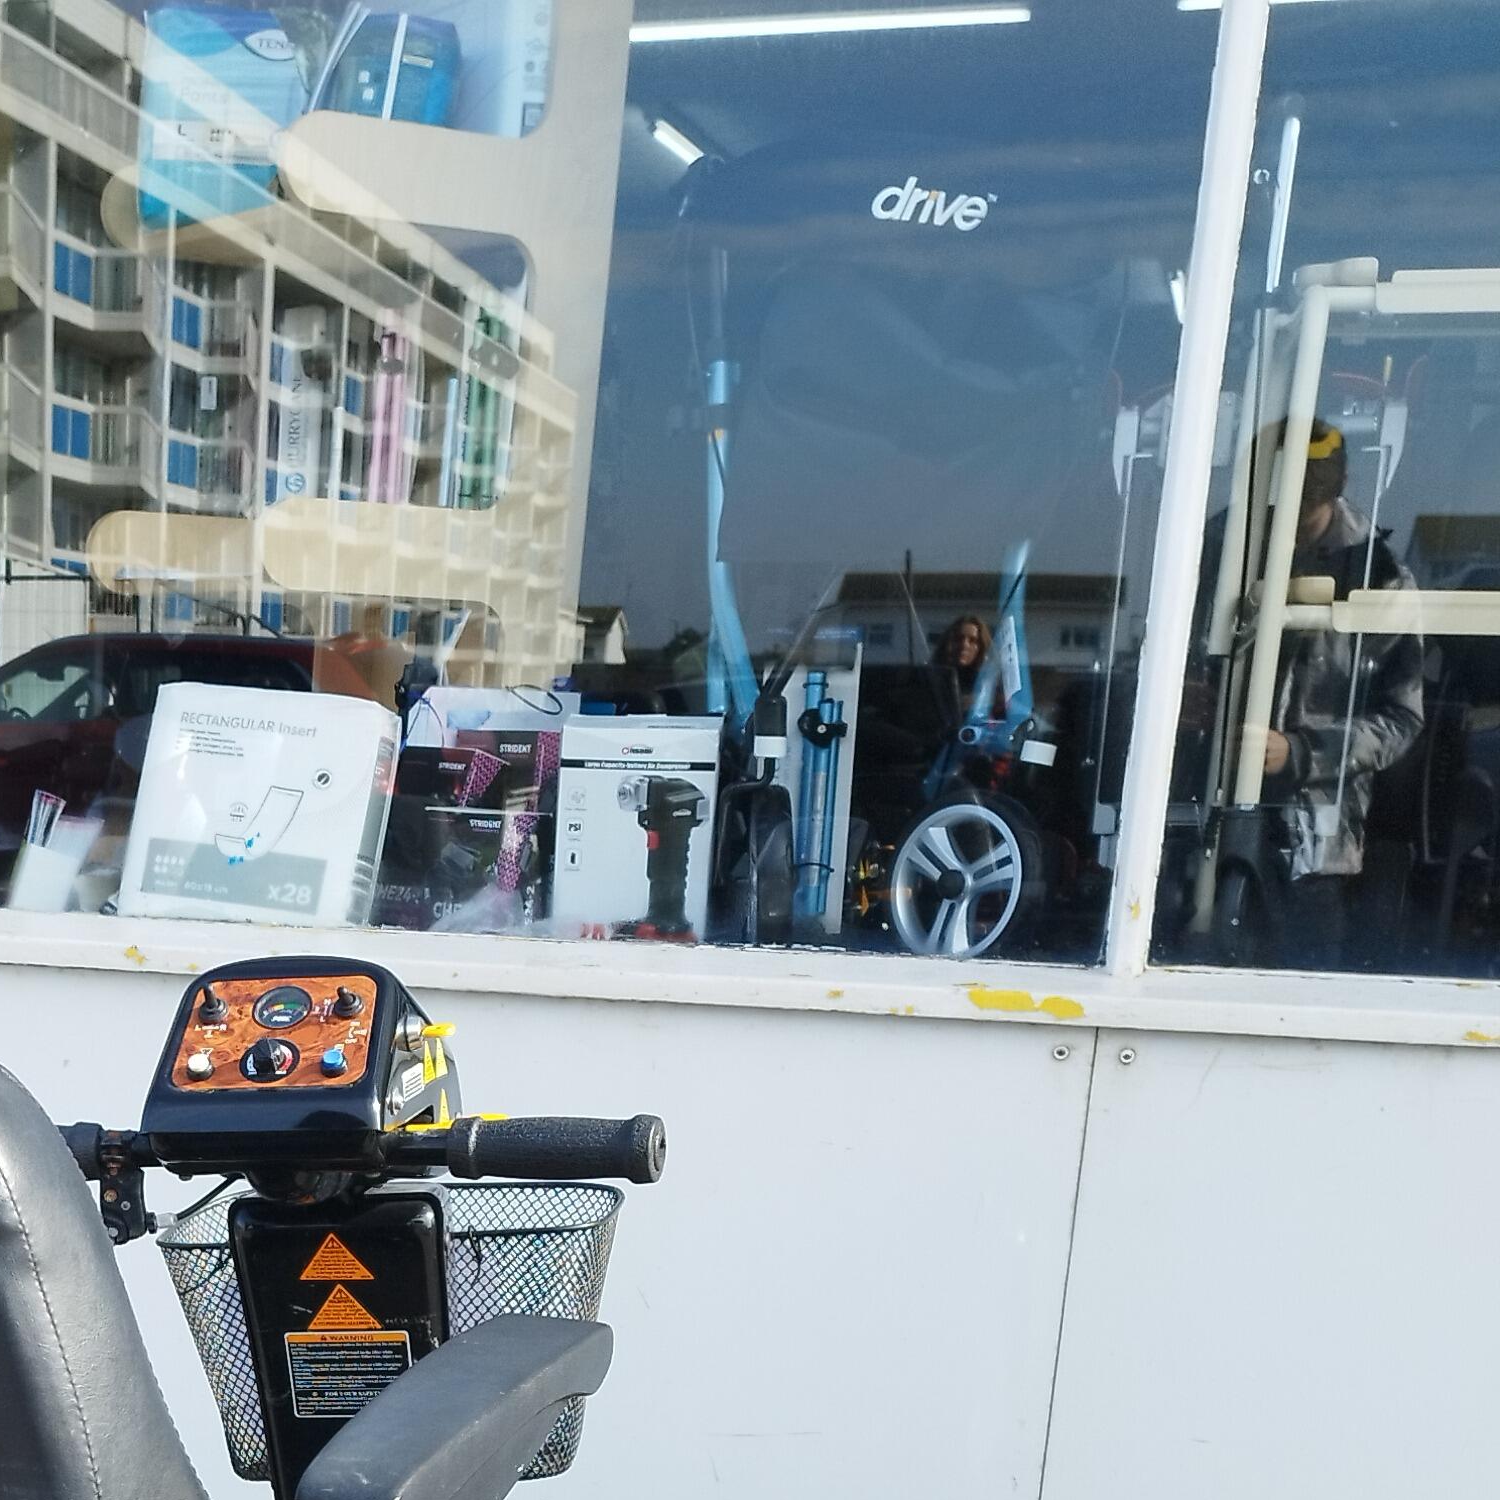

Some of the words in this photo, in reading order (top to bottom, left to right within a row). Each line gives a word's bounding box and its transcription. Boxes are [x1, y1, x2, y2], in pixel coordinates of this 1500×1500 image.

[258, 38, 293, 49] TEN
[871, 175, 989, 232] drive
[181, 711, 276, 732] RECTANGULAR
[279, 721, 317, 738] Insert
[500, 743, 532, 753] STRIDENT
[438, 762, 466, 771] STRIDENT
[469, 819, 501, 829] STRIDENT
[568, 823, 581, 832] PSI
[268, 882, 312, 905] x28
